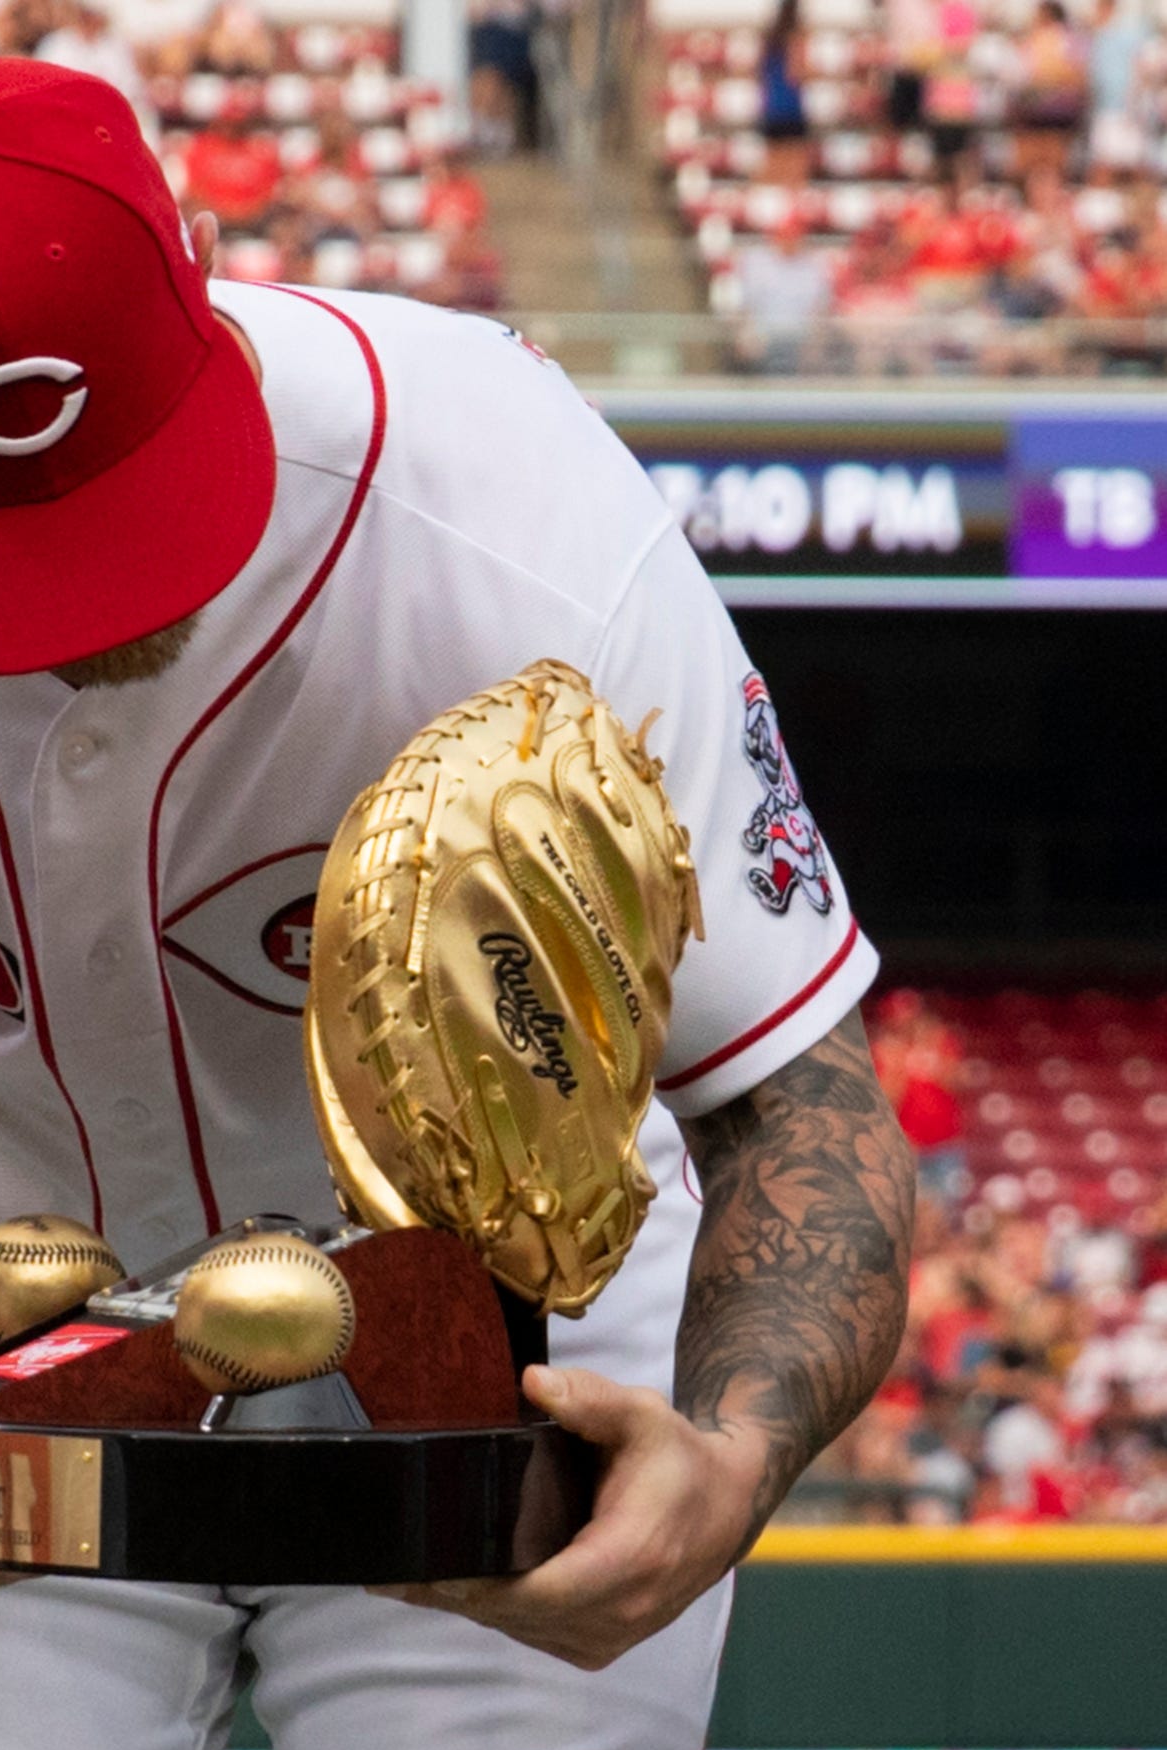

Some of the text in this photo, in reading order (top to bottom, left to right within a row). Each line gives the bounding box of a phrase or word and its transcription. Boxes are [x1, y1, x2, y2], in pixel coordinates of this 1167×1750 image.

[820, 463, 962, 552] PM
[1052, 468, 1156, 549] TB
[540, 831, 567, 875] THE
[564, 872, 599, 926] GOLD
[596, 926, 633, 993] GLOVE
[478, 932, 580, 1100] Rawlings
